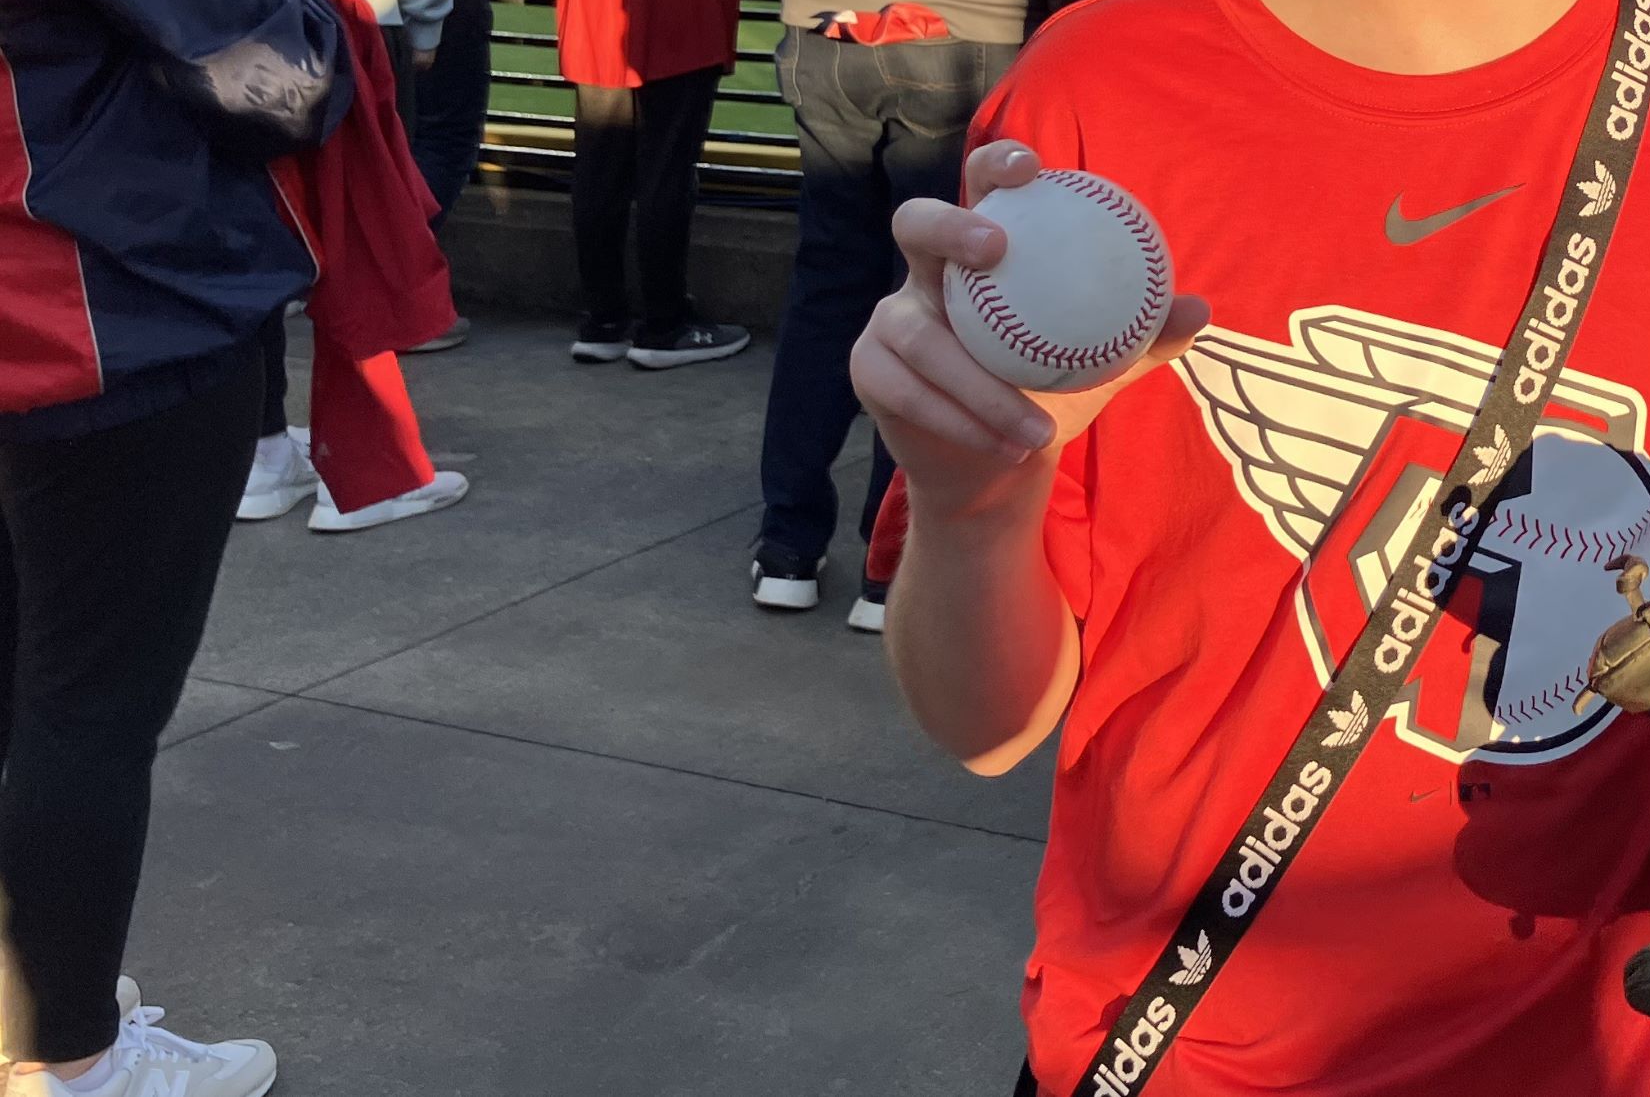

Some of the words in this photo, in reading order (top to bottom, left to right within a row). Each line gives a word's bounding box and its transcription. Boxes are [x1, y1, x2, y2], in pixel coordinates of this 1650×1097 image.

[1513, 231, 1598, 404] adidas
[1373, 500, 1481, 674] adidas
[1221, 760, 1333, 919] adidas
